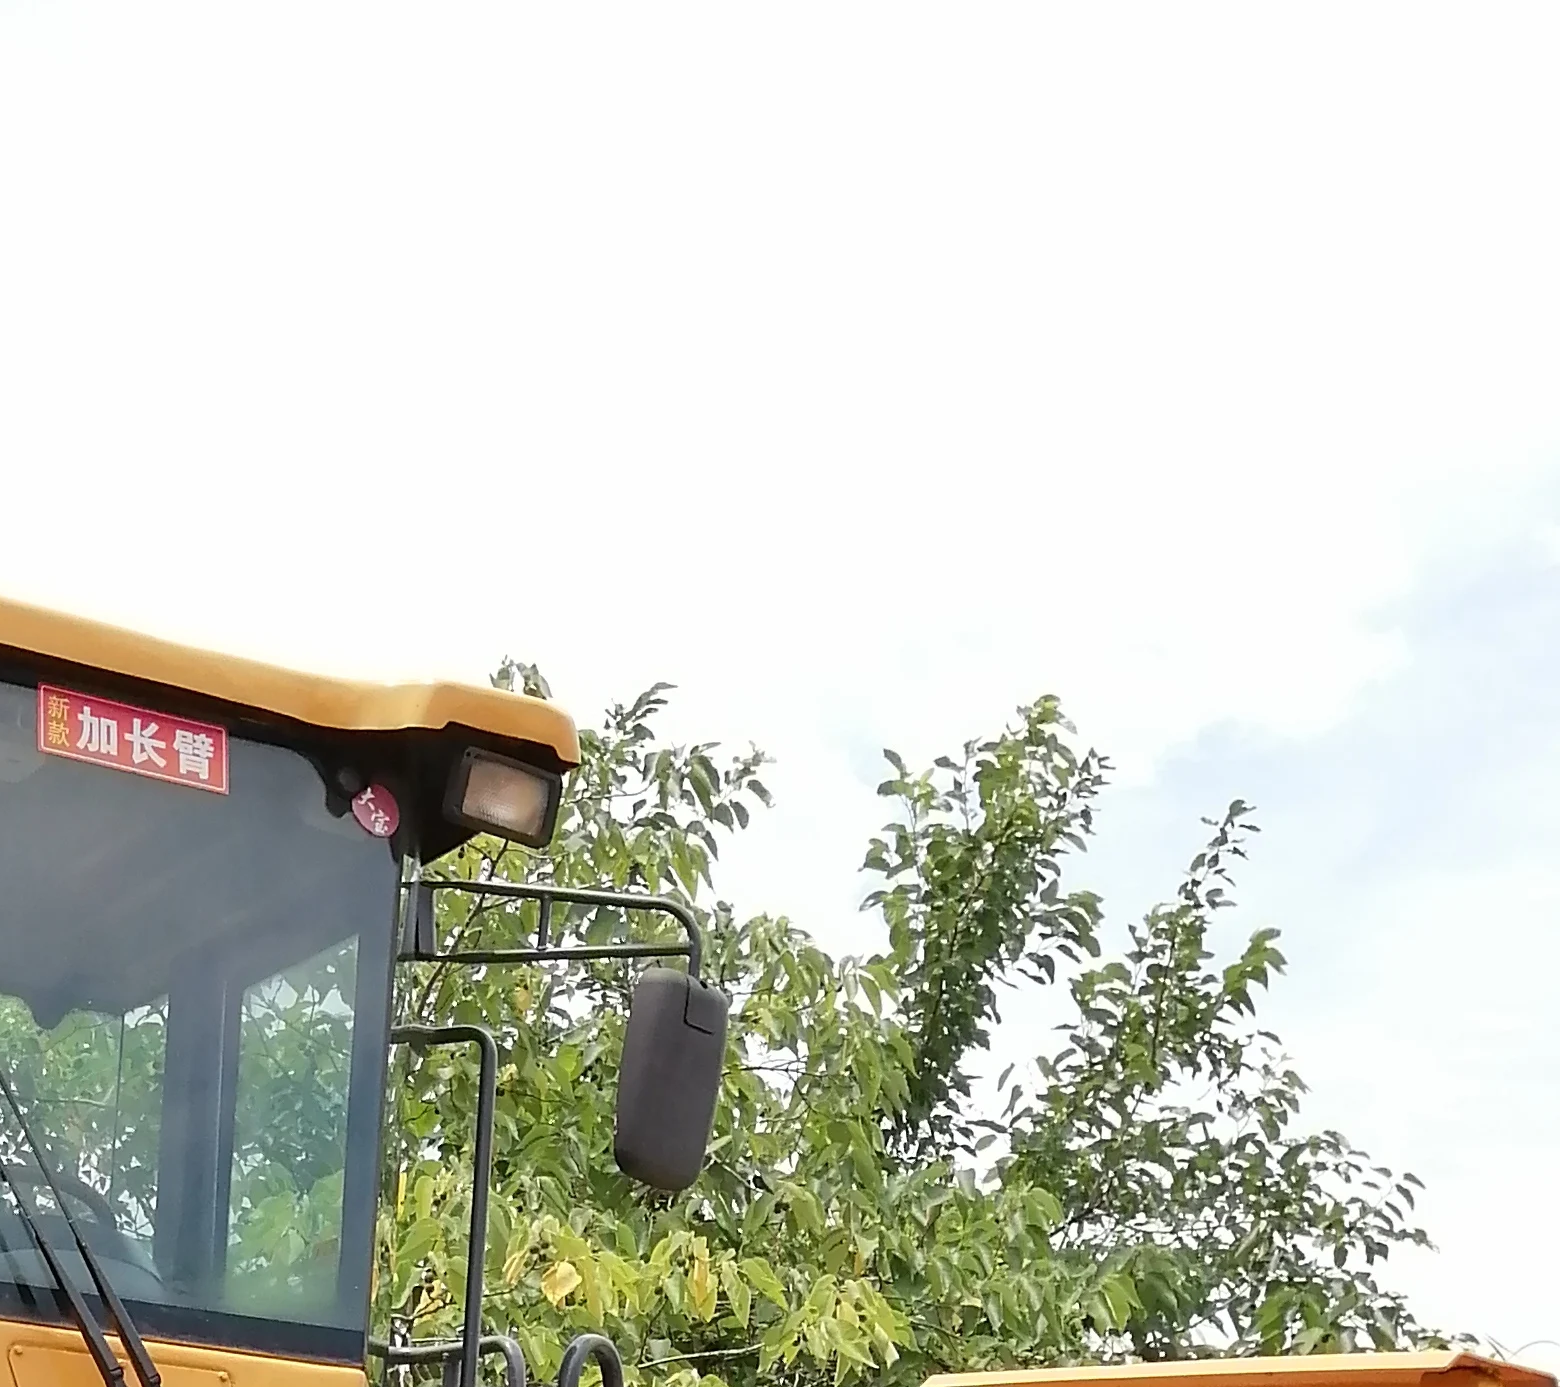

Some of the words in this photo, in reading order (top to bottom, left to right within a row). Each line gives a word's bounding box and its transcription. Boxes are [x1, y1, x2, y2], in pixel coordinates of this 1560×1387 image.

[47, 695, 70, 748] 新款
[76, 705, 215, 780] 加长臂
